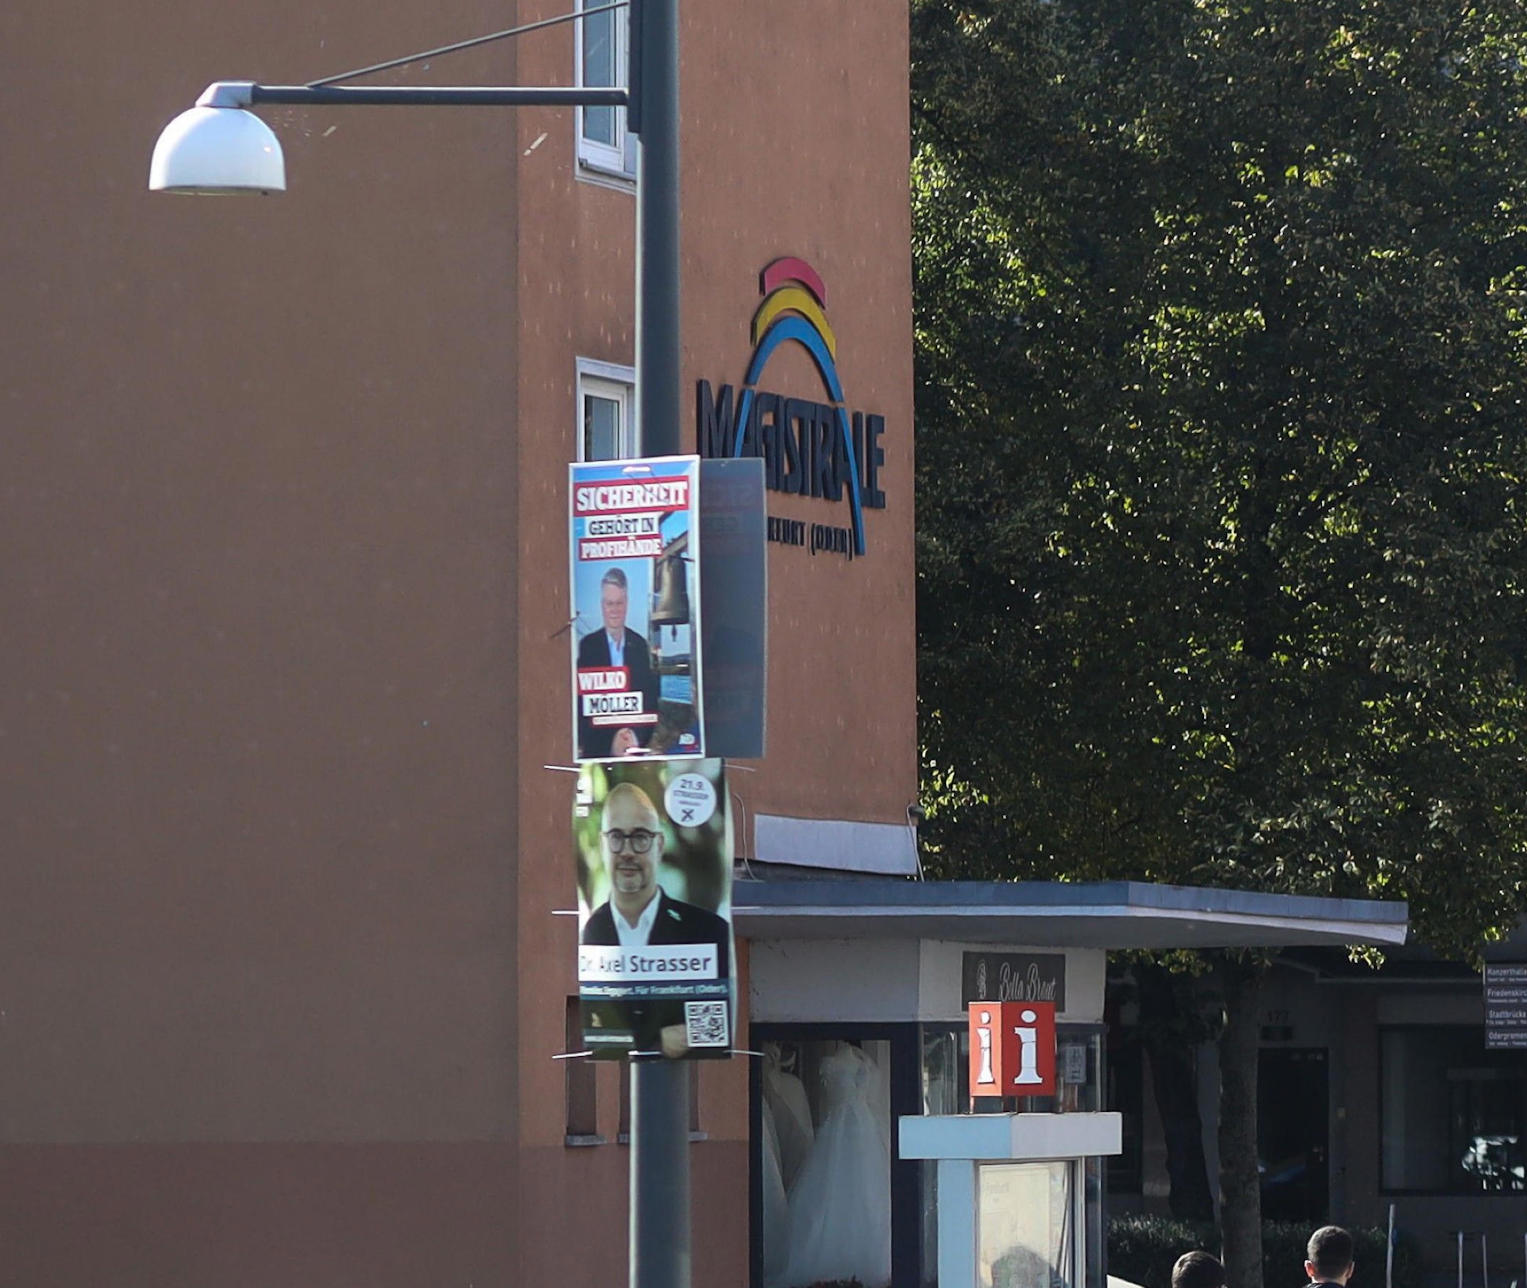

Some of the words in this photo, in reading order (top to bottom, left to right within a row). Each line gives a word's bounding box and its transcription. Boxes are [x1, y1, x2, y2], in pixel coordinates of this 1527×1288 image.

[697, 379, 886, 509] MAGISTRALE
[577, 481, 688, 512] SICHERHEIT
[589, 515, 638, 536] GEHÖRT
[641, 517, 655, 533] IN
[580, 536, 662, 559] PROFIHÄNDE
[579, 671, 627, 691] WILKO
[589, 693, 639, 714] MÖLLER
[630, 955, 711, 973] Strasser
